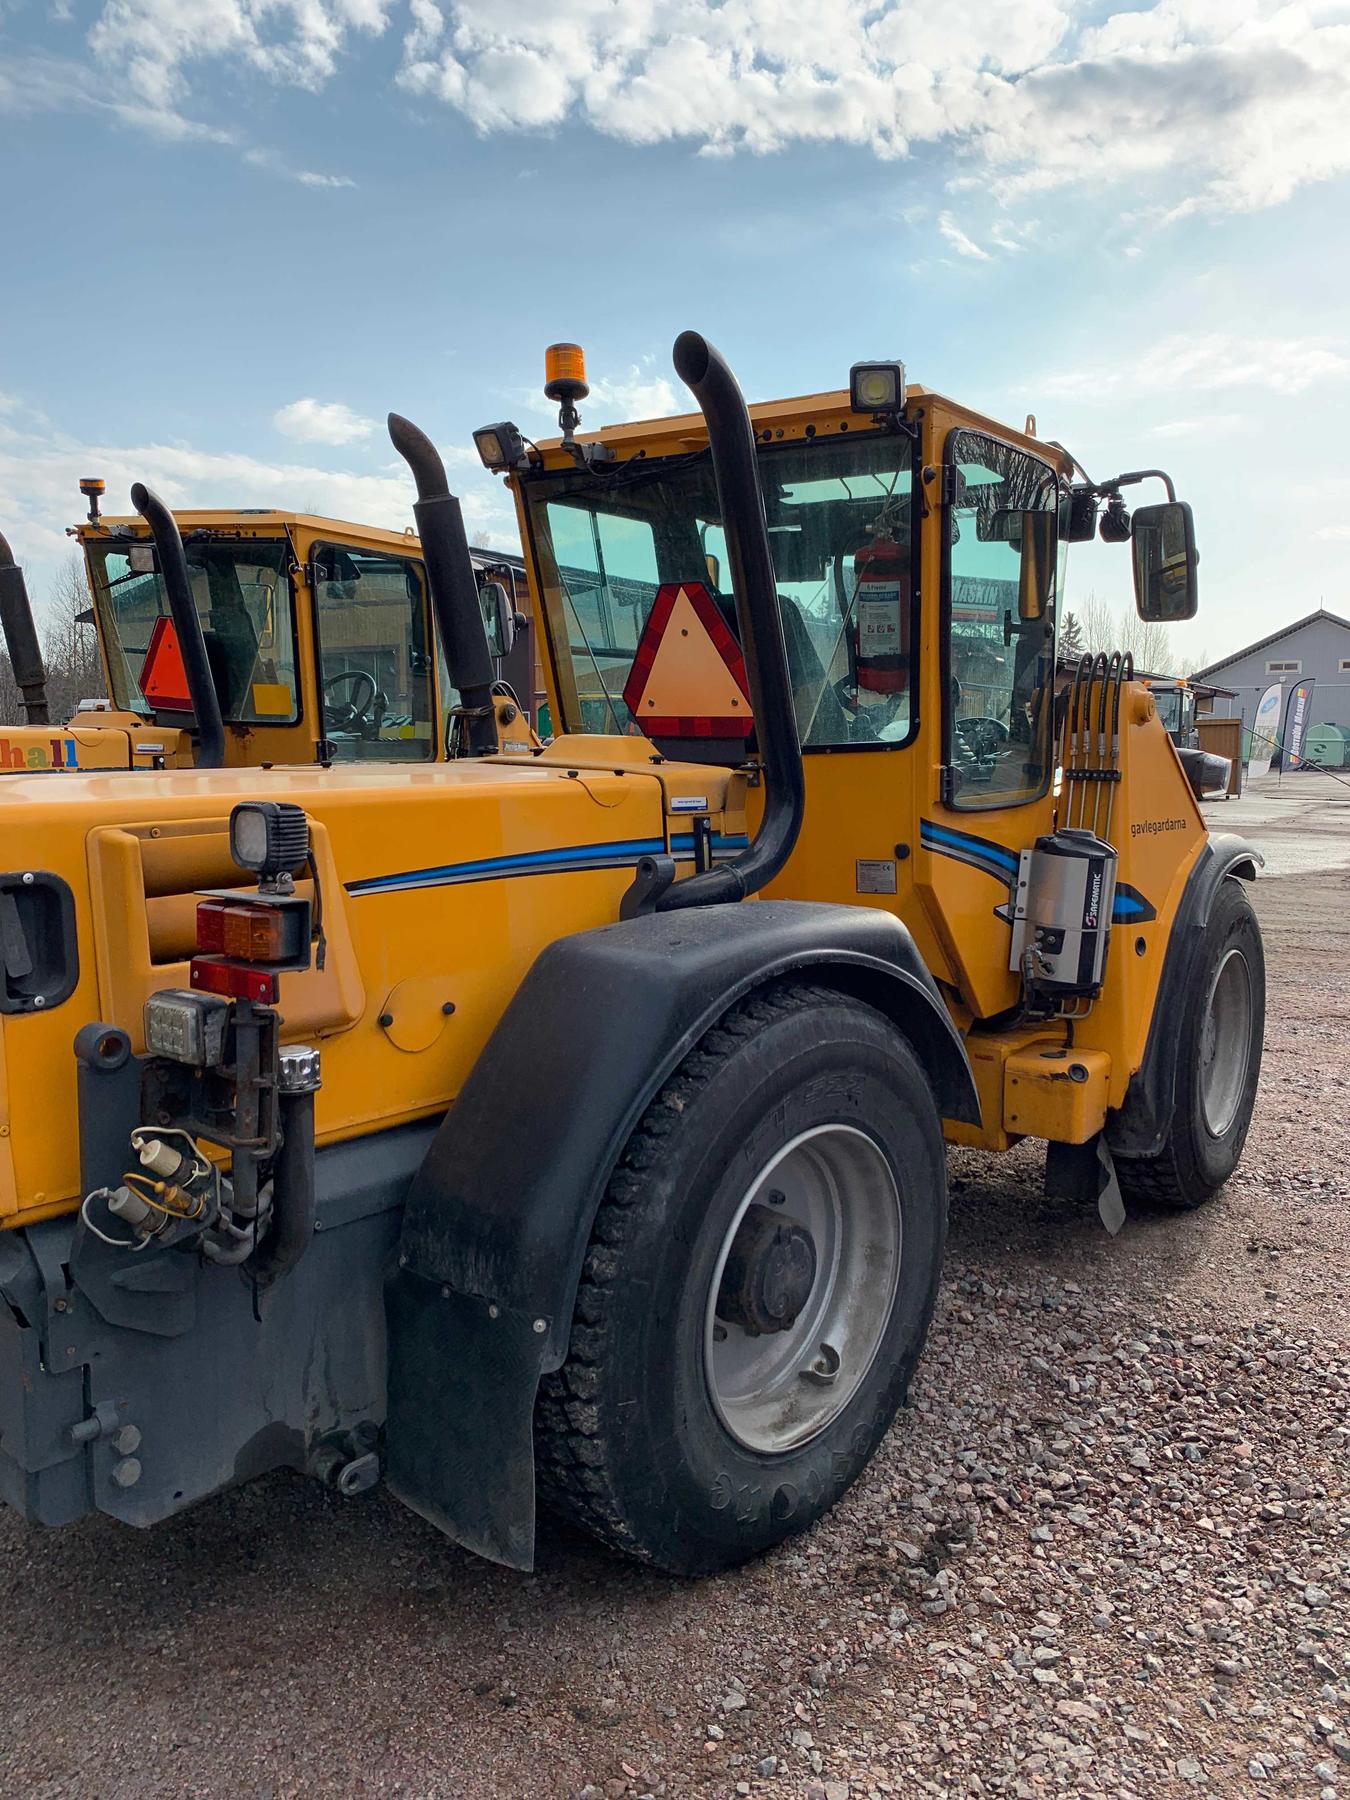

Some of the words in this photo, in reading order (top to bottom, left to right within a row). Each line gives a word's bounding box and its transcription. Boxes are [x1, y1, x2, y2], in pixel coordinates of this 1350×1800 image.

[0, 739, 78, 768] hall
[1131, 819, 1187, 837] gavlegardarna
[1090, 873, 1101, 916] SAFEMATIC
